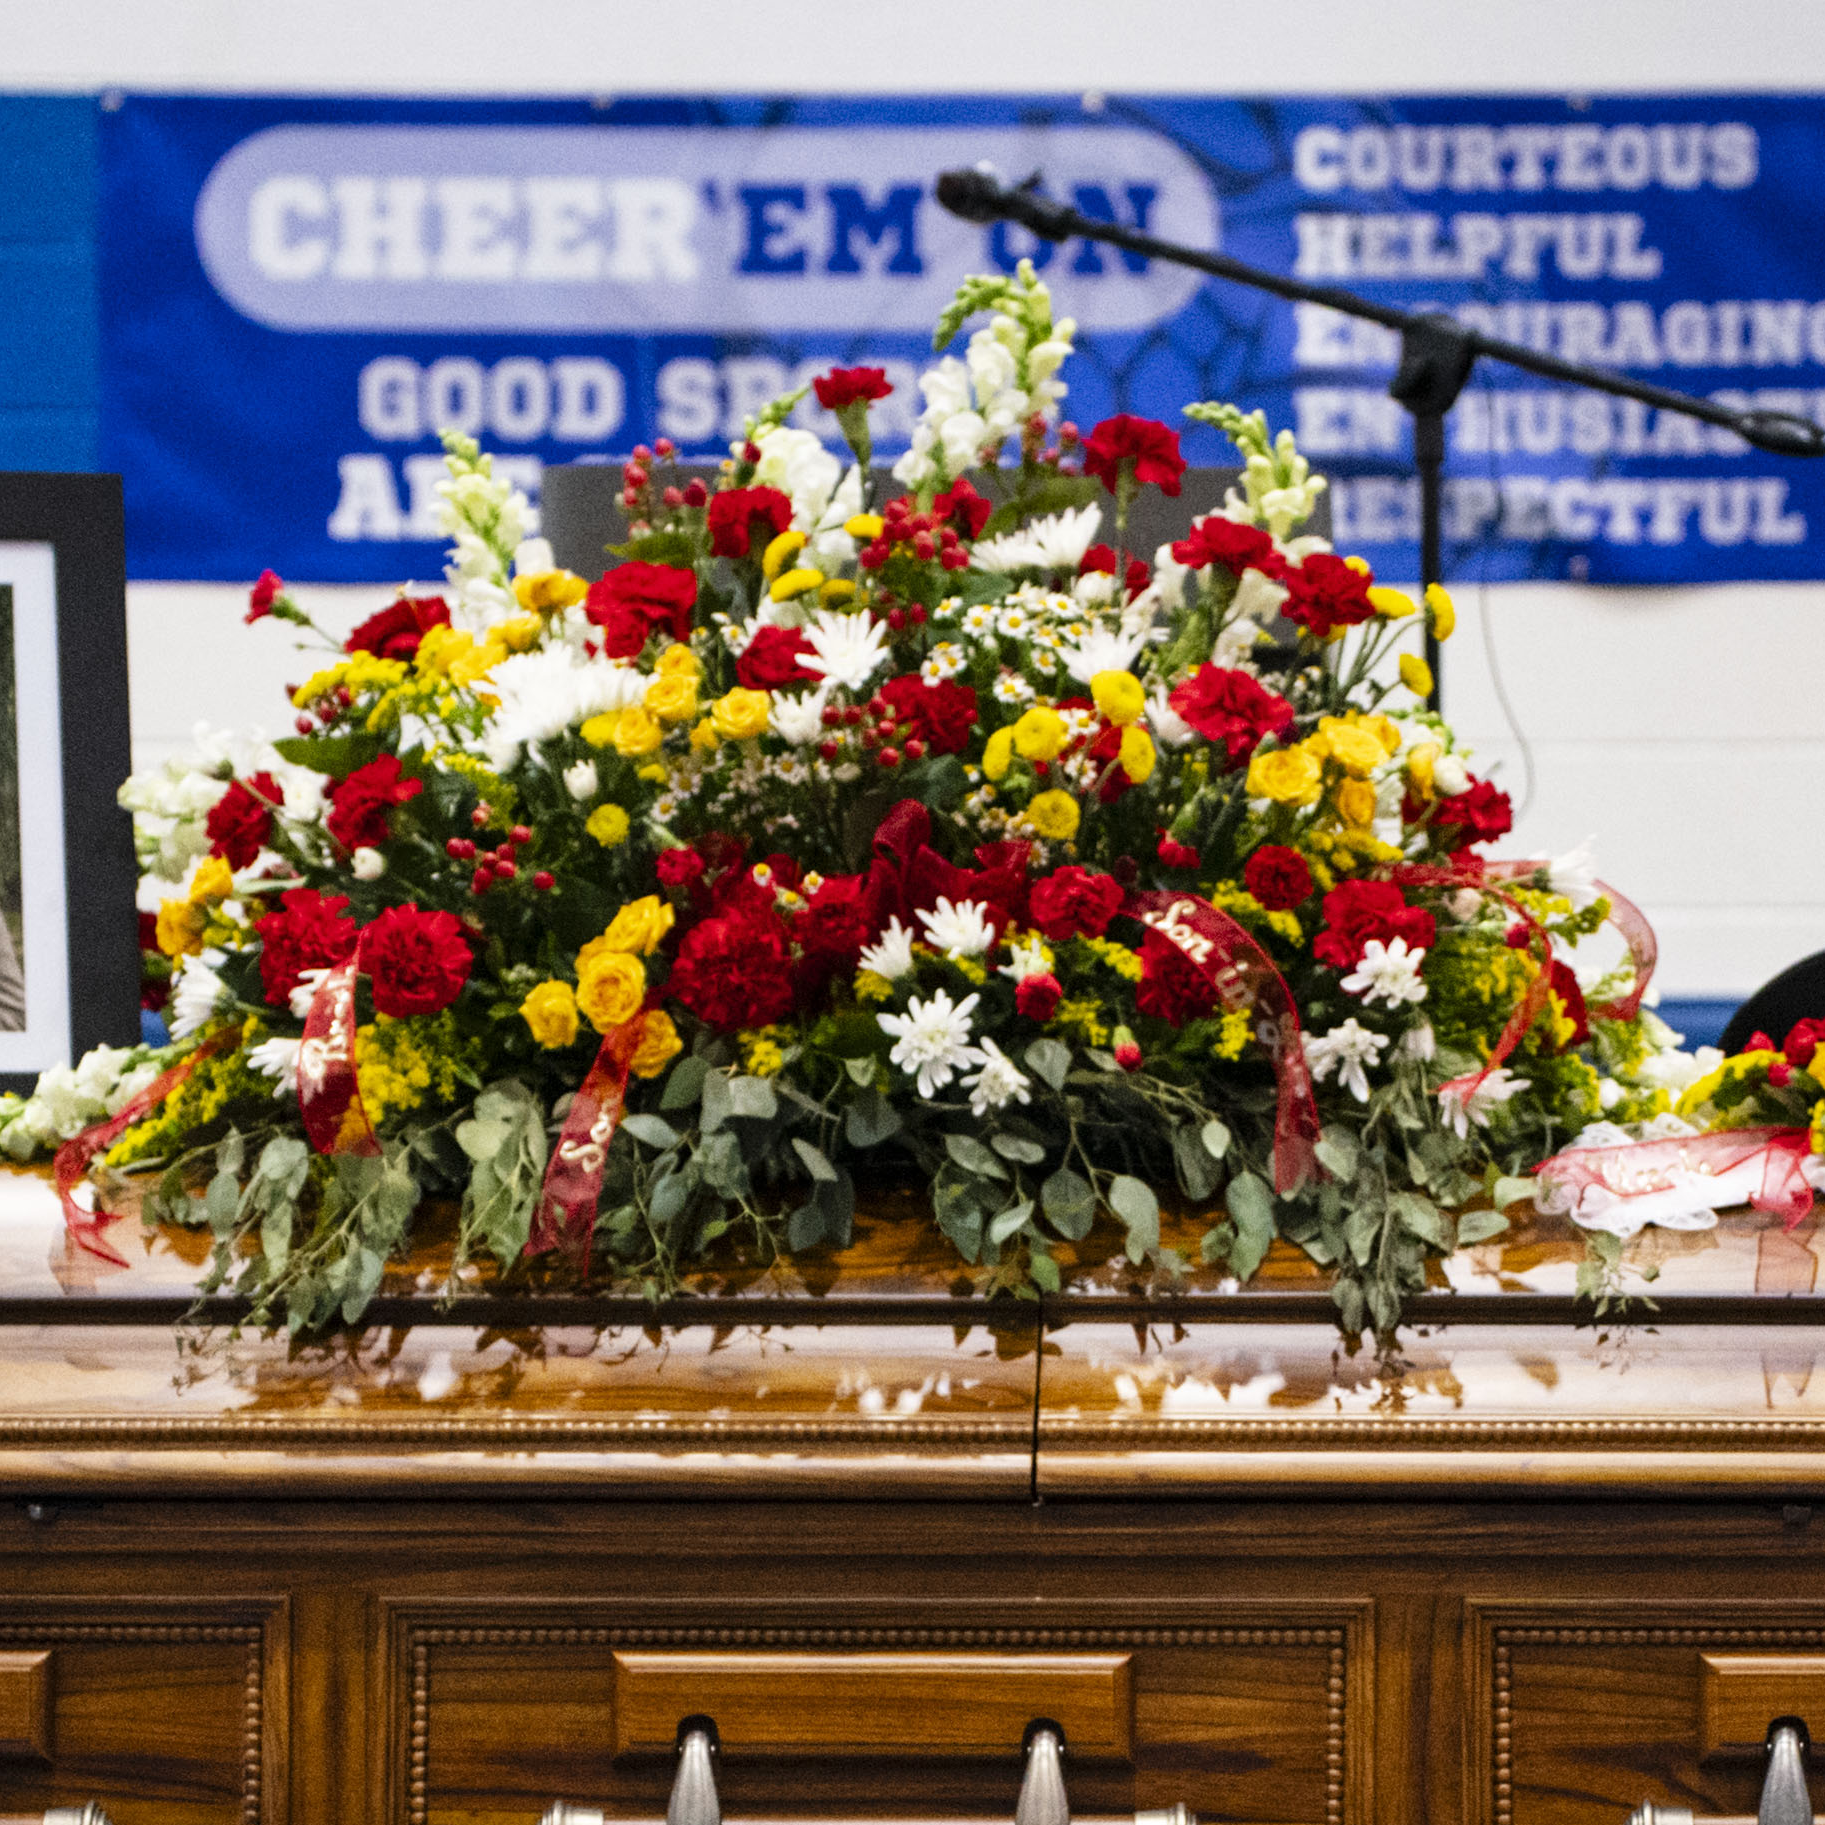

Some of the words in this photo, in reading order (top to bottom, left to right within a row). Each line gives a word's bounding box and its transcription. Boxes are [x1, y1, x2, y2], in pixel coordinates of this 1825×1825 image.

[1294, 122, 1760, 192] COURTEOUS
[248, 177, 699, 281] CHEER
[1294, 211, 1663, 281] HELPFUL
[356, 355, 625, 441] GOOD
